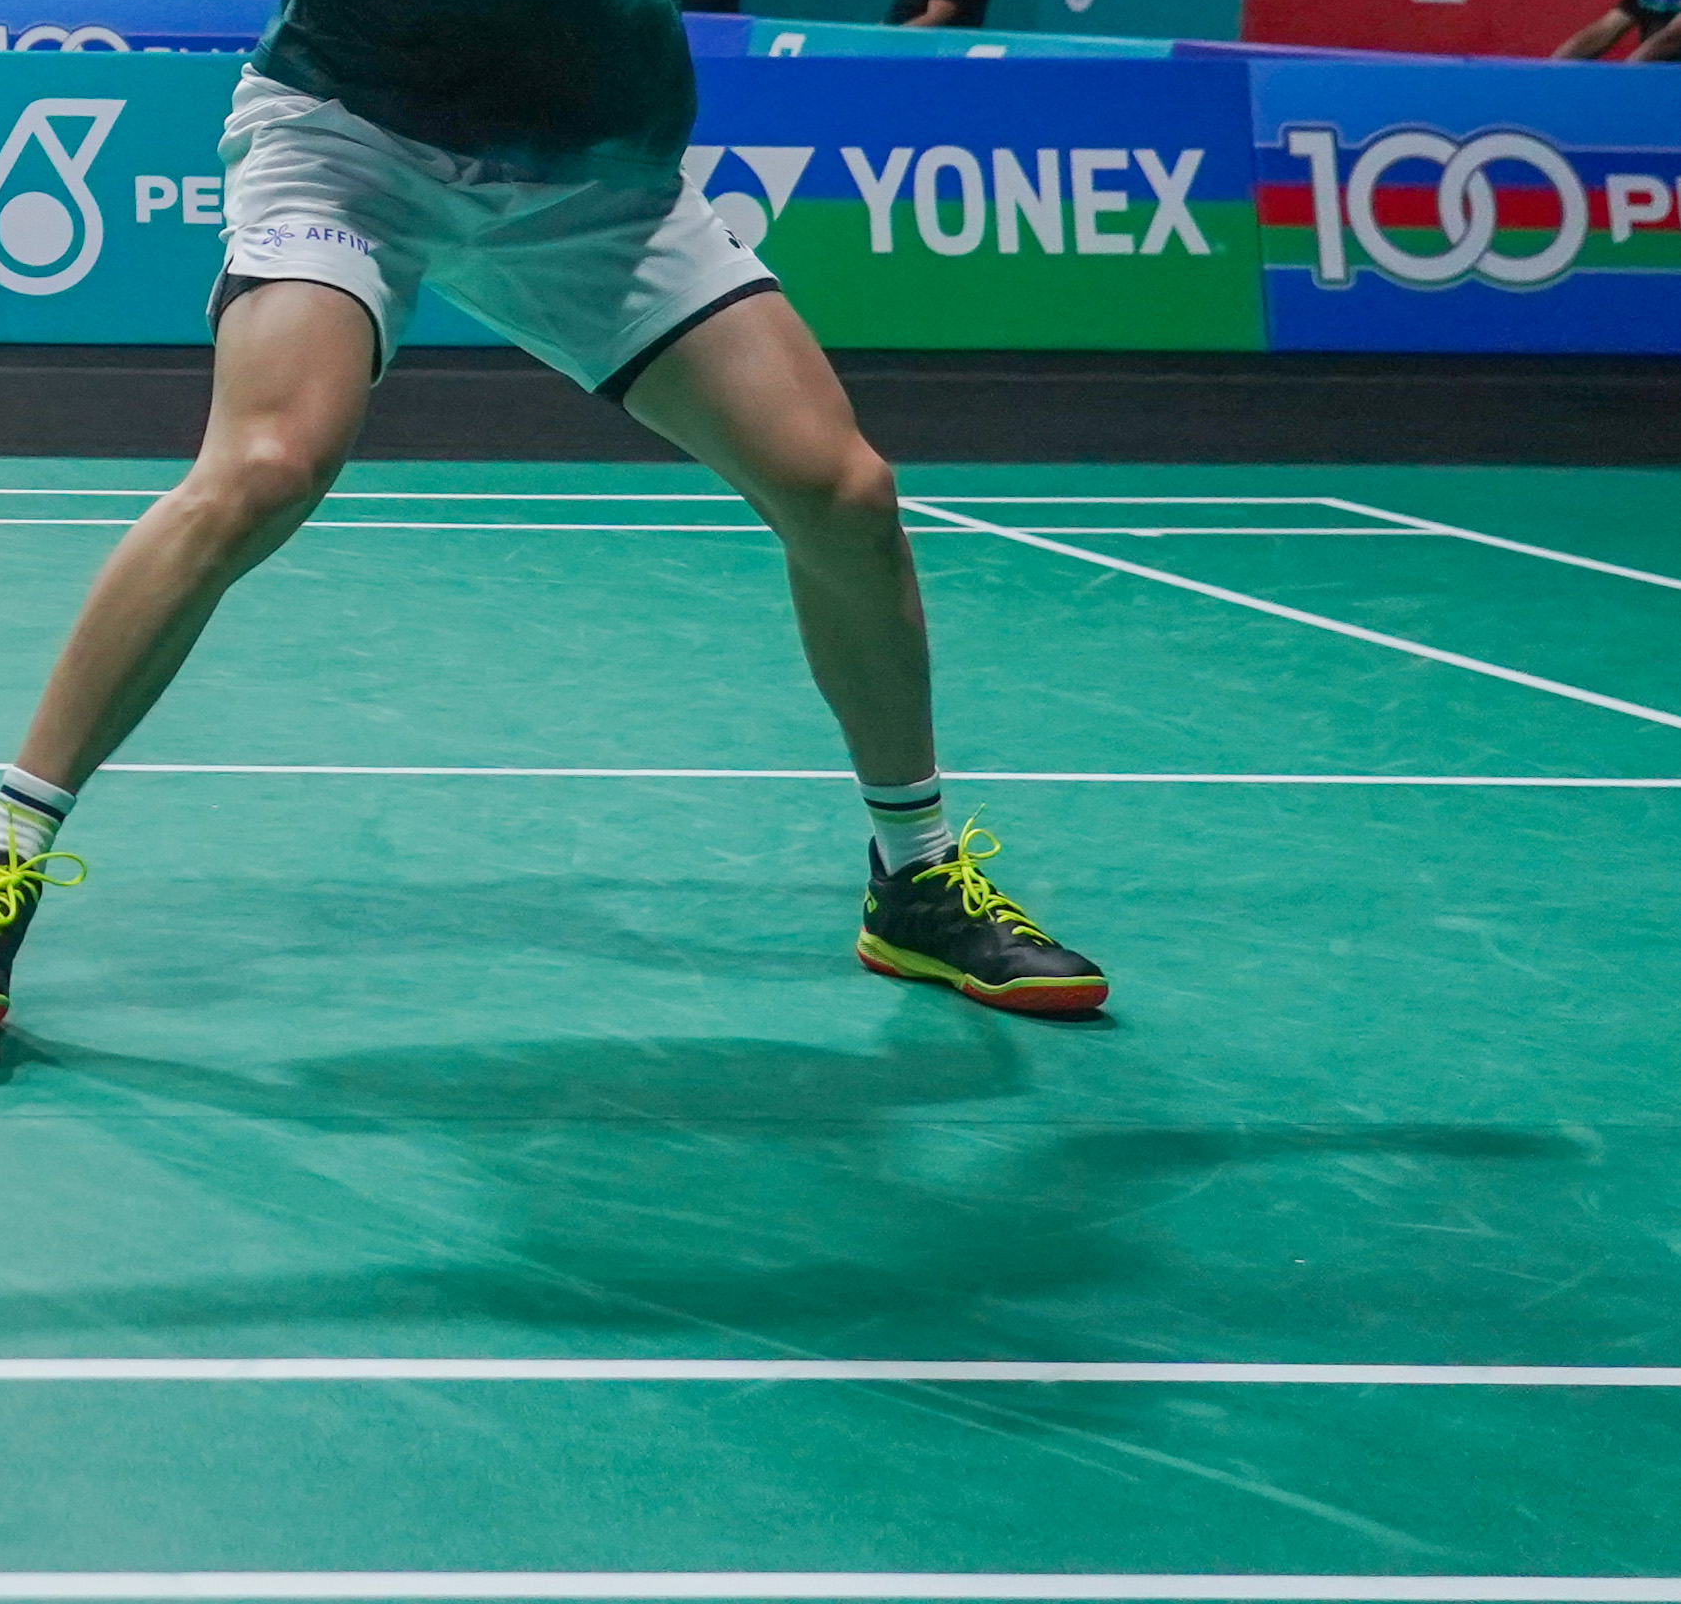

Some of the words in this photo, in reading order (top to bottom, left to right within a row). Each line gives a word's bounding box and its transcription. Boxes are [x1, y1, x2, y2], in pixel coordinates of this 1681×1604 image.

[840, 144, 1211, 257] YONEX
[1604, 173, 1681, 244] P
[306, 227, 369, 256] AFFIN
